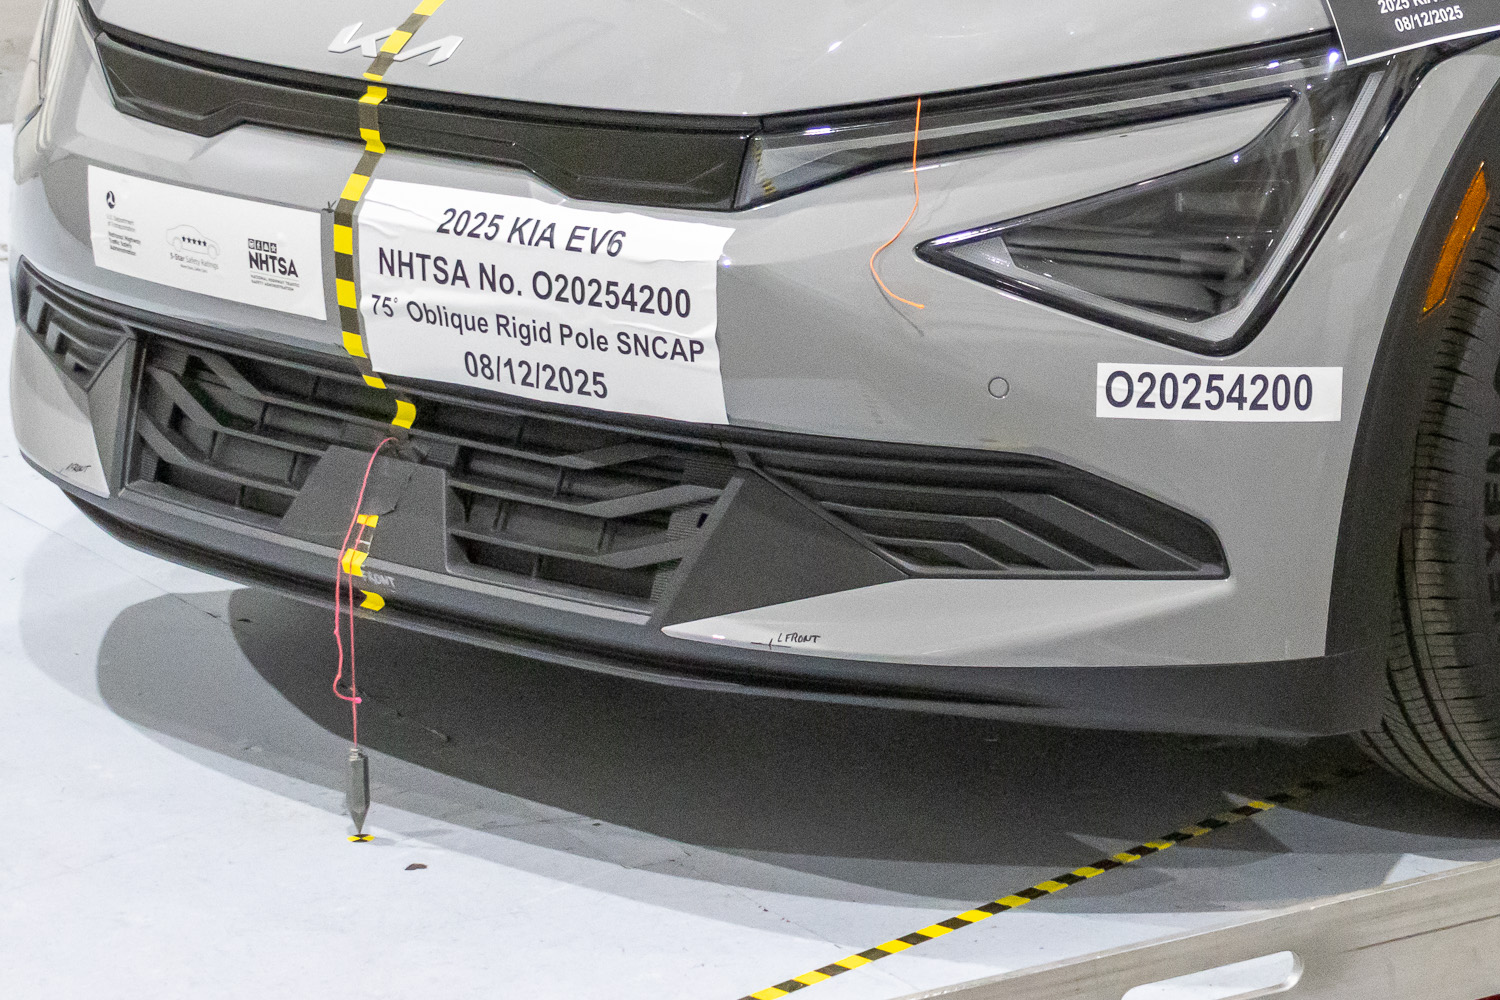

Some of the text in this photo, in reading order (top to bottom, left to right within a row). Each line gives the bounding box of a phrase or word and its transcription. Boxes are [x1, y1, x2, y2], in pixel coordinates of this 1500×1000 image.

[1394, 5, 1464, 33] 08/12/2025
[328, 21, 463, 67] KA
[436, 208, 627, 257] 2025 KIA EV6
[248, 250, 299, 278] NHTSA
[378, 247, 691, 318] NHTSA No. O20254200
[371, 294, 705, 363] 75° Oblique Rigid Pole SNCAP
[463, 351, 609, 399] 08/12/2025
[1105, 370, 1313, 412] O20254200
